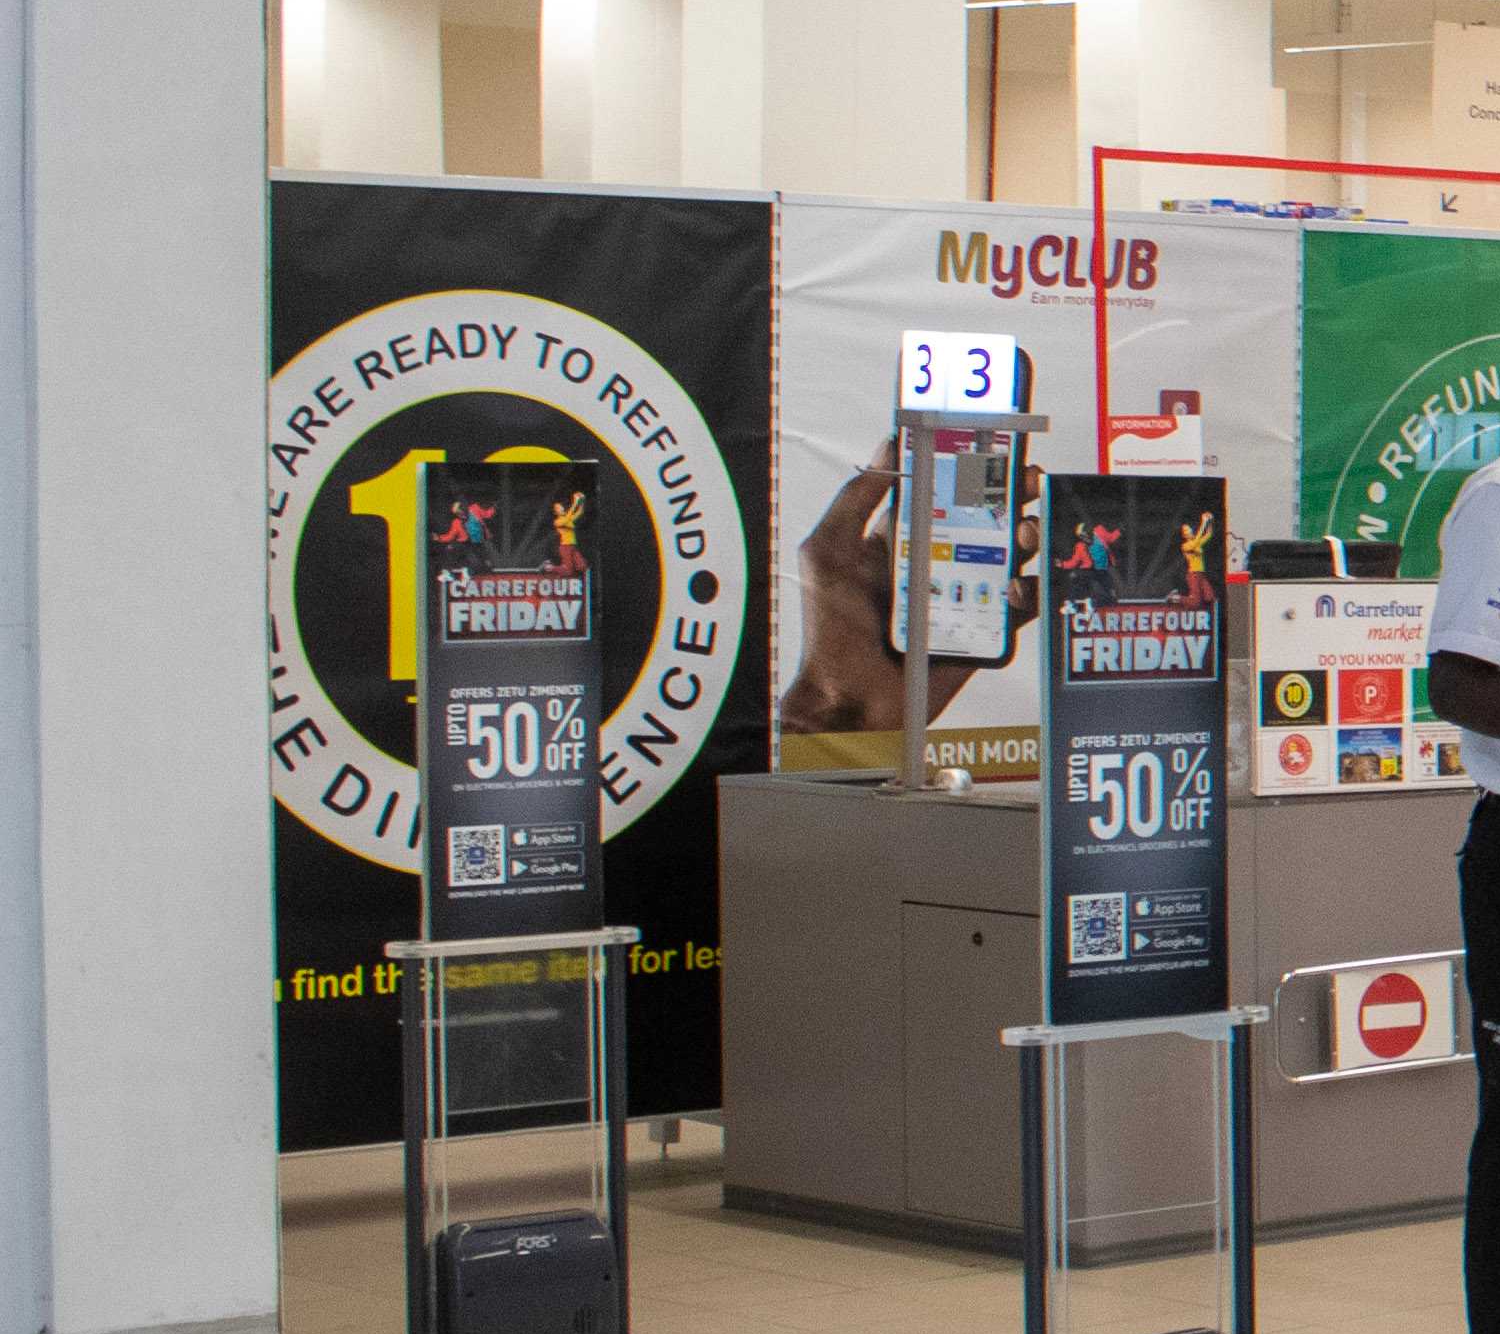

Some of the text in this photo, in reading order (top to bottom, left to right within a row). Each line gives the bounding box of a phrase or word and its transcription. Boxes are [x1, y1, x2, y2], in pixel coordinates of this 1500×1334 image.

[936, 229, 1160, 300] MyCLUB
[1111, 418, 1173, 431] INFORMATION
[353, 322, 706, 560] READY TO REFUND
[450, 578, 583, 598] CARREFOUR
[450, 601, 582, 632] FRIDAY
[1072, 610, 1211, 633] CARREFOUR
[1344, 601, 1425, 618] Carrefour
[1072, 635, 1211, 673] FRIDAY
[1318, 653, 1365, 667] DO YOU
[450, 686, 527, 699] OFFERS ZETU
[1071, 731, 1211, 748] OFFERS ZETU ZIMENICE!
[546, 742, 585, 771] OFF
[1170, 798, 1211, 833] OFF
[292, 943, 677, 1000] find for
